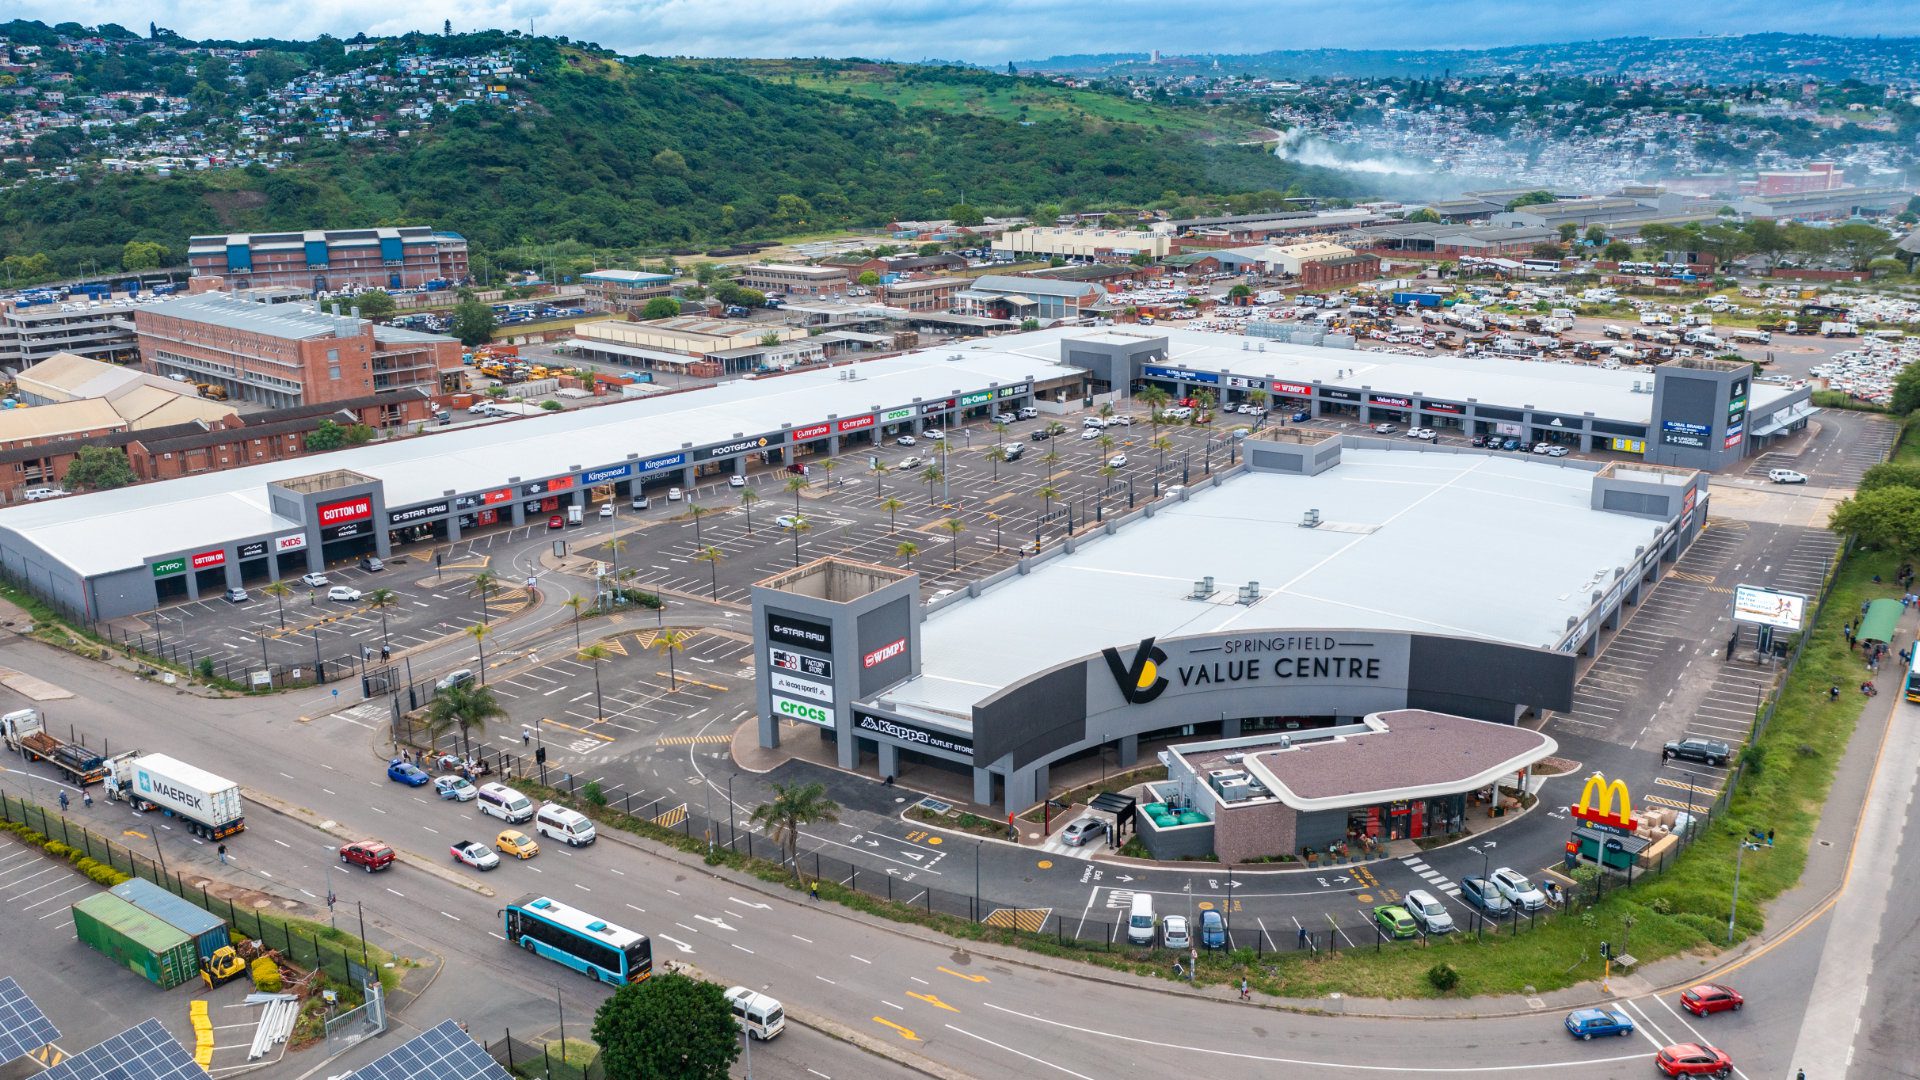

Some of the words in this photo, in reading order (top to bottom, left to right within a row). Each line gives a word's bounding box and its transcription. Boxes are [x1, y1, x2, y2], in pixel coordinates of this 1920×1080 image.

[888, 409, 909, 419] crocs
[712, 440, 757, 456] FOOTGEAR
[645, 454, 680, 470] Kingsmead
[588, 466, 626, 482] Kingsmead
[323, 506, 354, 520] COTTON
[356, 503, 368, 514] ON
[393, 508, 425, 522] G-STAR
[426, 504, 446, 516] RAW
[283, 538, 301, 547] KIDS
[160, 562, 180, 571] TYPO
[194, 556, 212, 565] COTTON
[212, 554, 224, 562] ON
[774, 625, 804, 638] G-STAR
[806, 632, 824, 642] RAW
[874, 639, 905, 662] WIMPY
[1224, 637, 1336, 654] SPRINGFIELD
[806, 659, 825, 668] FACTORY
[808, 666, 822, 674] STORE
[1178, 659, 1260, 687] VALUE
[1274, 658, 1380, 679] CENTRE
[791, 682, 800, 690] coq
[801, 684, 818, 694] sportif
[780, 701, 826, 722] crocs
[879, 720, 928, 743] Kappa
[930, 738, 953, 750] OUTLET
[954, 744, 974, 754] STORE
[153, 780, 202, 811] MAERSK
[1594, 824, 1608, 832] Drive
[1608, 826, 1620, 834] Thru
